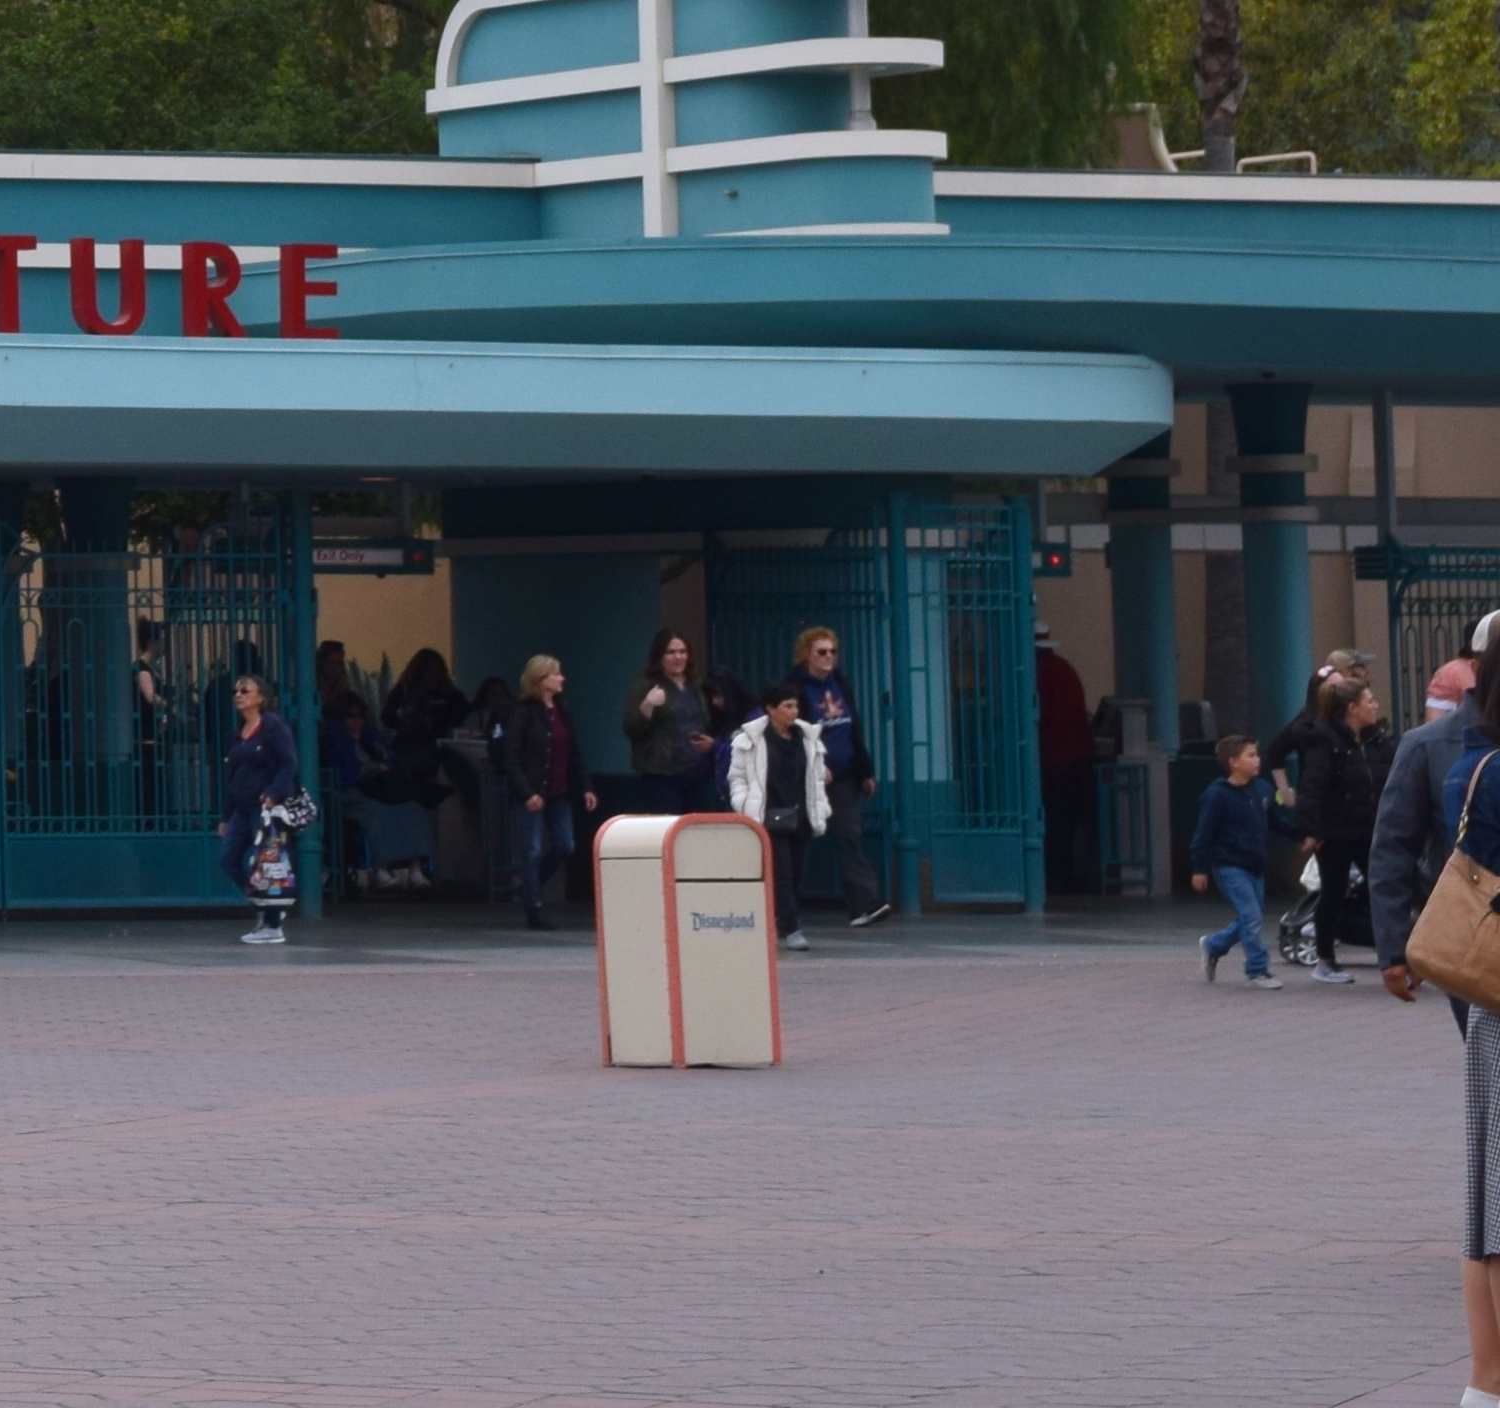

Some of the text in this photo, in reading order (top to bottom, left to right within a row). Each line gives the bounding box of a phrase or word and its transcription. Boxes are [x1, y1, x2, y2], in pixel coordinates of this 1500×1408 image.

[316, 549, 364, 562] Exit Only
[690, 911, 755, 933] Disneyland
